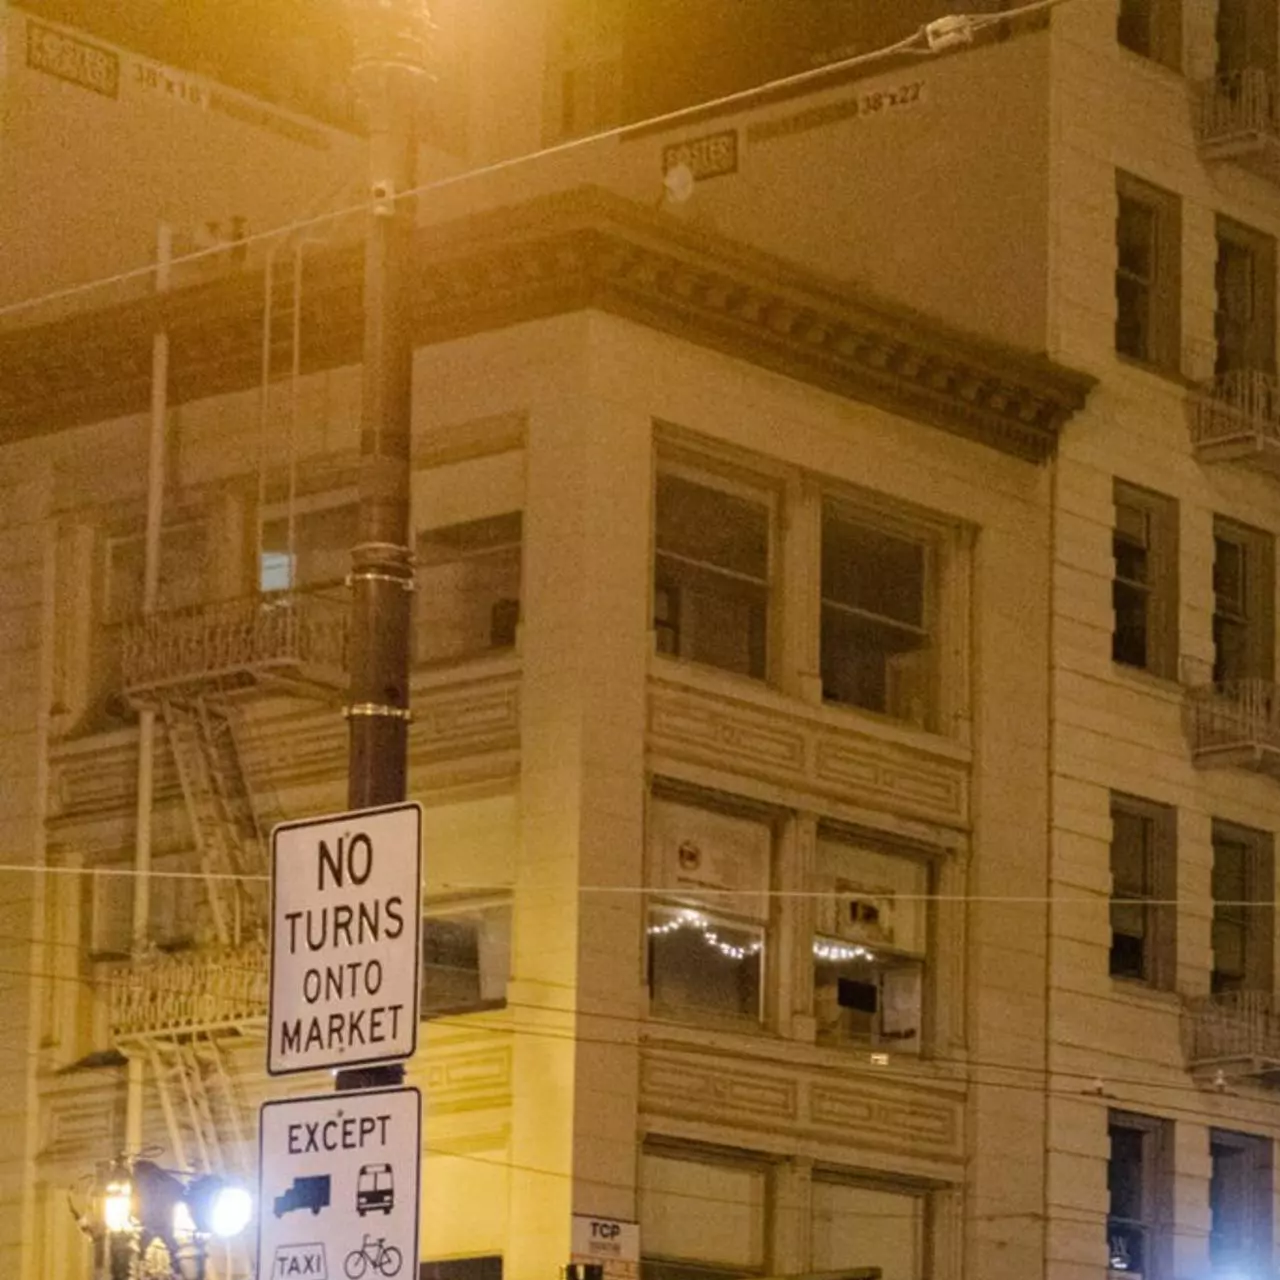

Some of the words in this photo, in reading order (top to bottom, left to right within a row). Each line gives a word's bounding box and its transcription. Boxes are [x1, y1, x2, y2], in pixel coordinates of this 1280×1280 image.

[318, 832, 373, 890] NO
[285, 897, 404, 953] TURNS
[303, 959, 382, 1004] ONTO
[281, 1004, 404, 1055] MARKET
[288, 1115, 391, 1154] EXCEPT
[277, 1256, 321, 1275] TAXI
